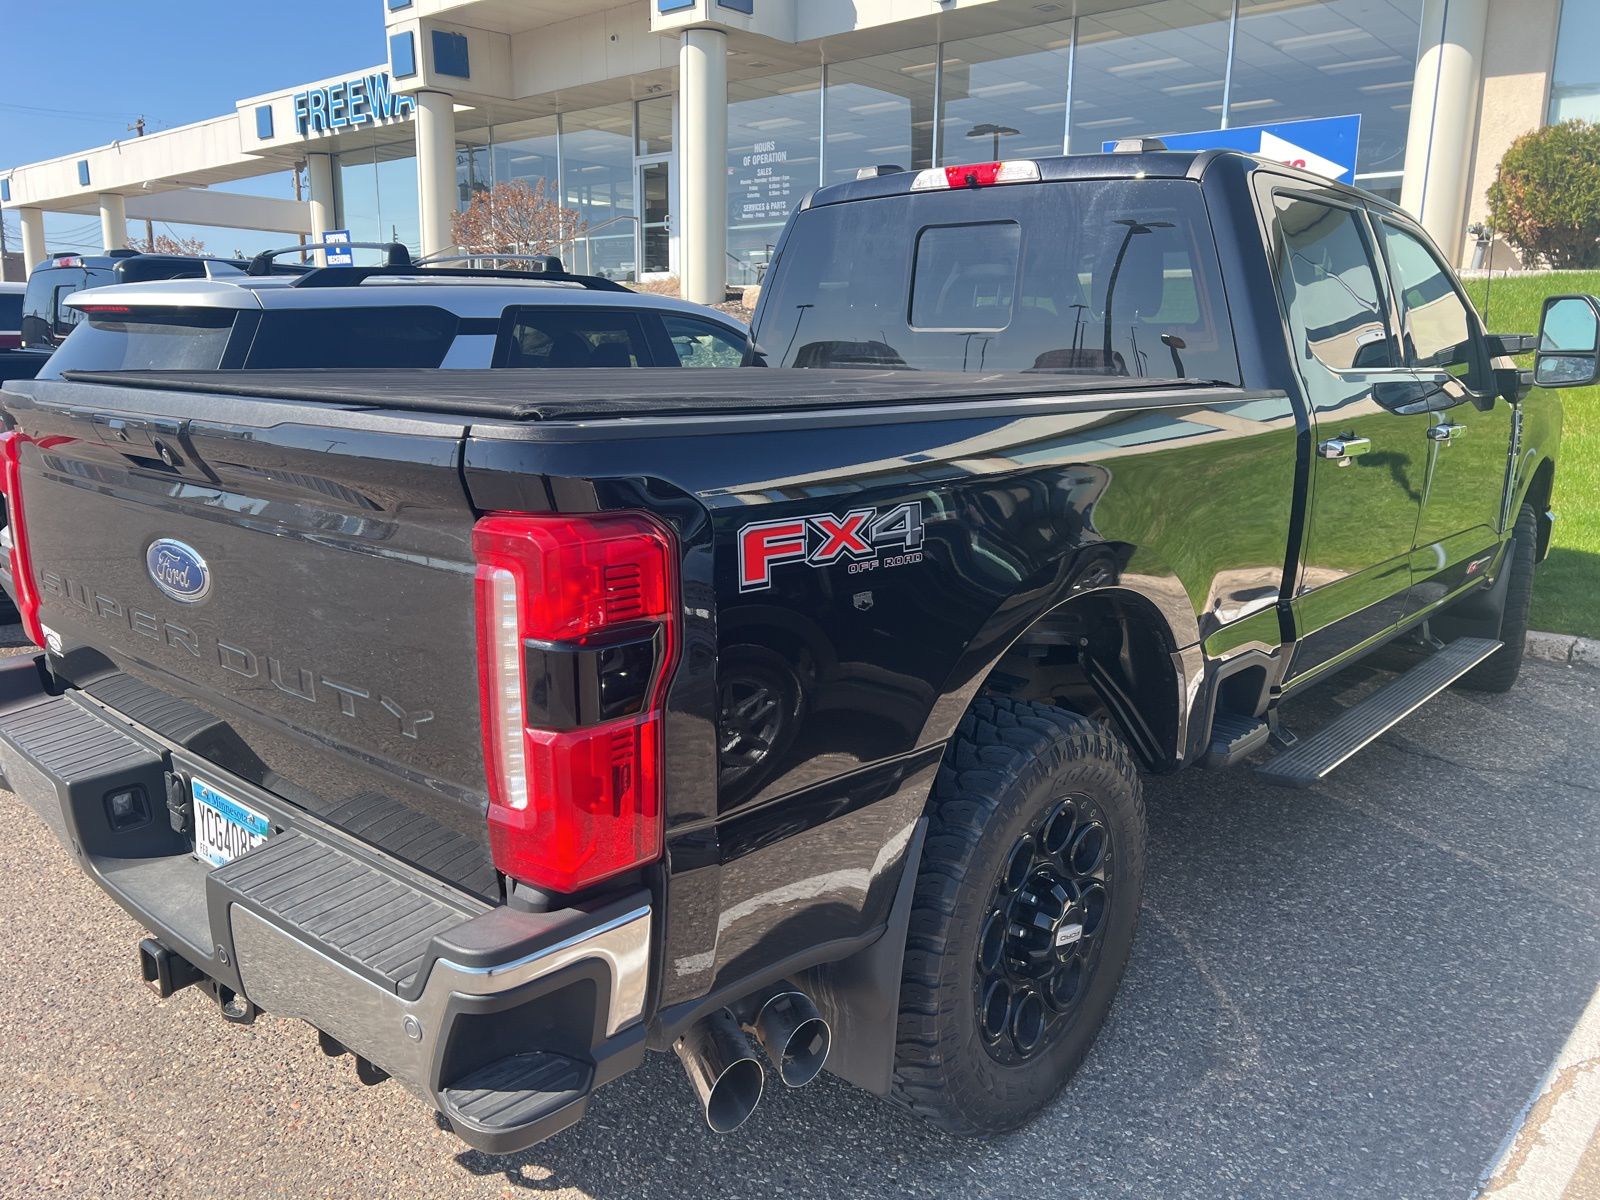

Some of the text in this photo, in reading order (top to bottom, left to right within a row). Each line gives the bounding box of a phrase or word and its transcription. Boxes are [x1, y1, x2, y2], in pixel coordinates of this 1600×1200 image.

[754, 141, 775, 153] HOURS
[743, 151, 787, 166] OF OPERATION
[757, 167, 772, 176] SALES
[771, 200, 786, 210] PARTS
[737, 501, 924, 594] FX4
[157, 550, 190, 588] Ford
[848, 552, 923, 574] OFF ROAD
[41, 570, 434, 740] SUPER DUTY
